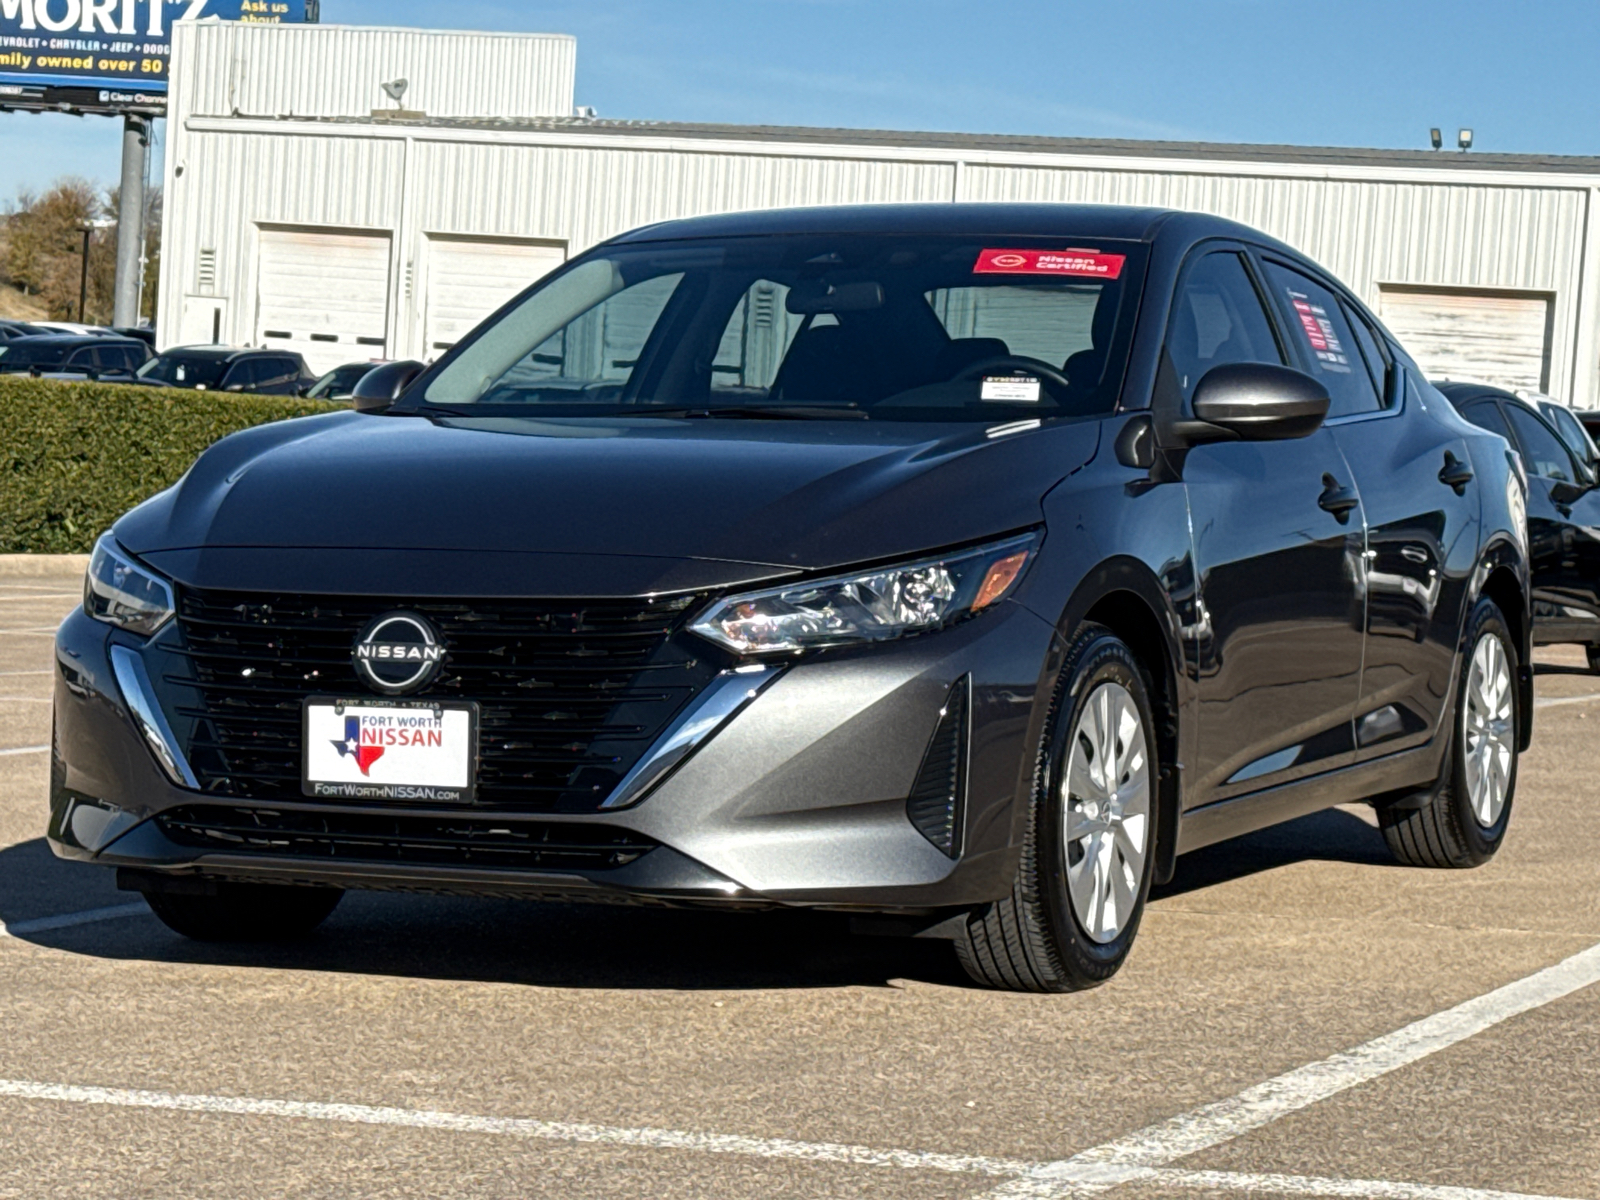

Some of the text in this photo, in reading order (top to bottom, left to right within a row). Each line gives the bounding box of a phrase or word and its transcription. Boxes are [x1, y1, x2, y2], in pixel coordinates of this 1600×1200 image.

[241, 0, 289, 13] Ask us
[50, 38, 100, 51] CHRYSLER
[110, 41, 133, 53] JEEP
[37, 55, 93, 69] owned
[98, 59, 137, 72] over
[141, 58, 163, 73] 50
[110, 91, 133, 102] Clear
[357, 645, 438, 659] NISSAN
[362, 716, 442, 728] FORT WORTH
[362, 728, 442, 747] NISSAN
